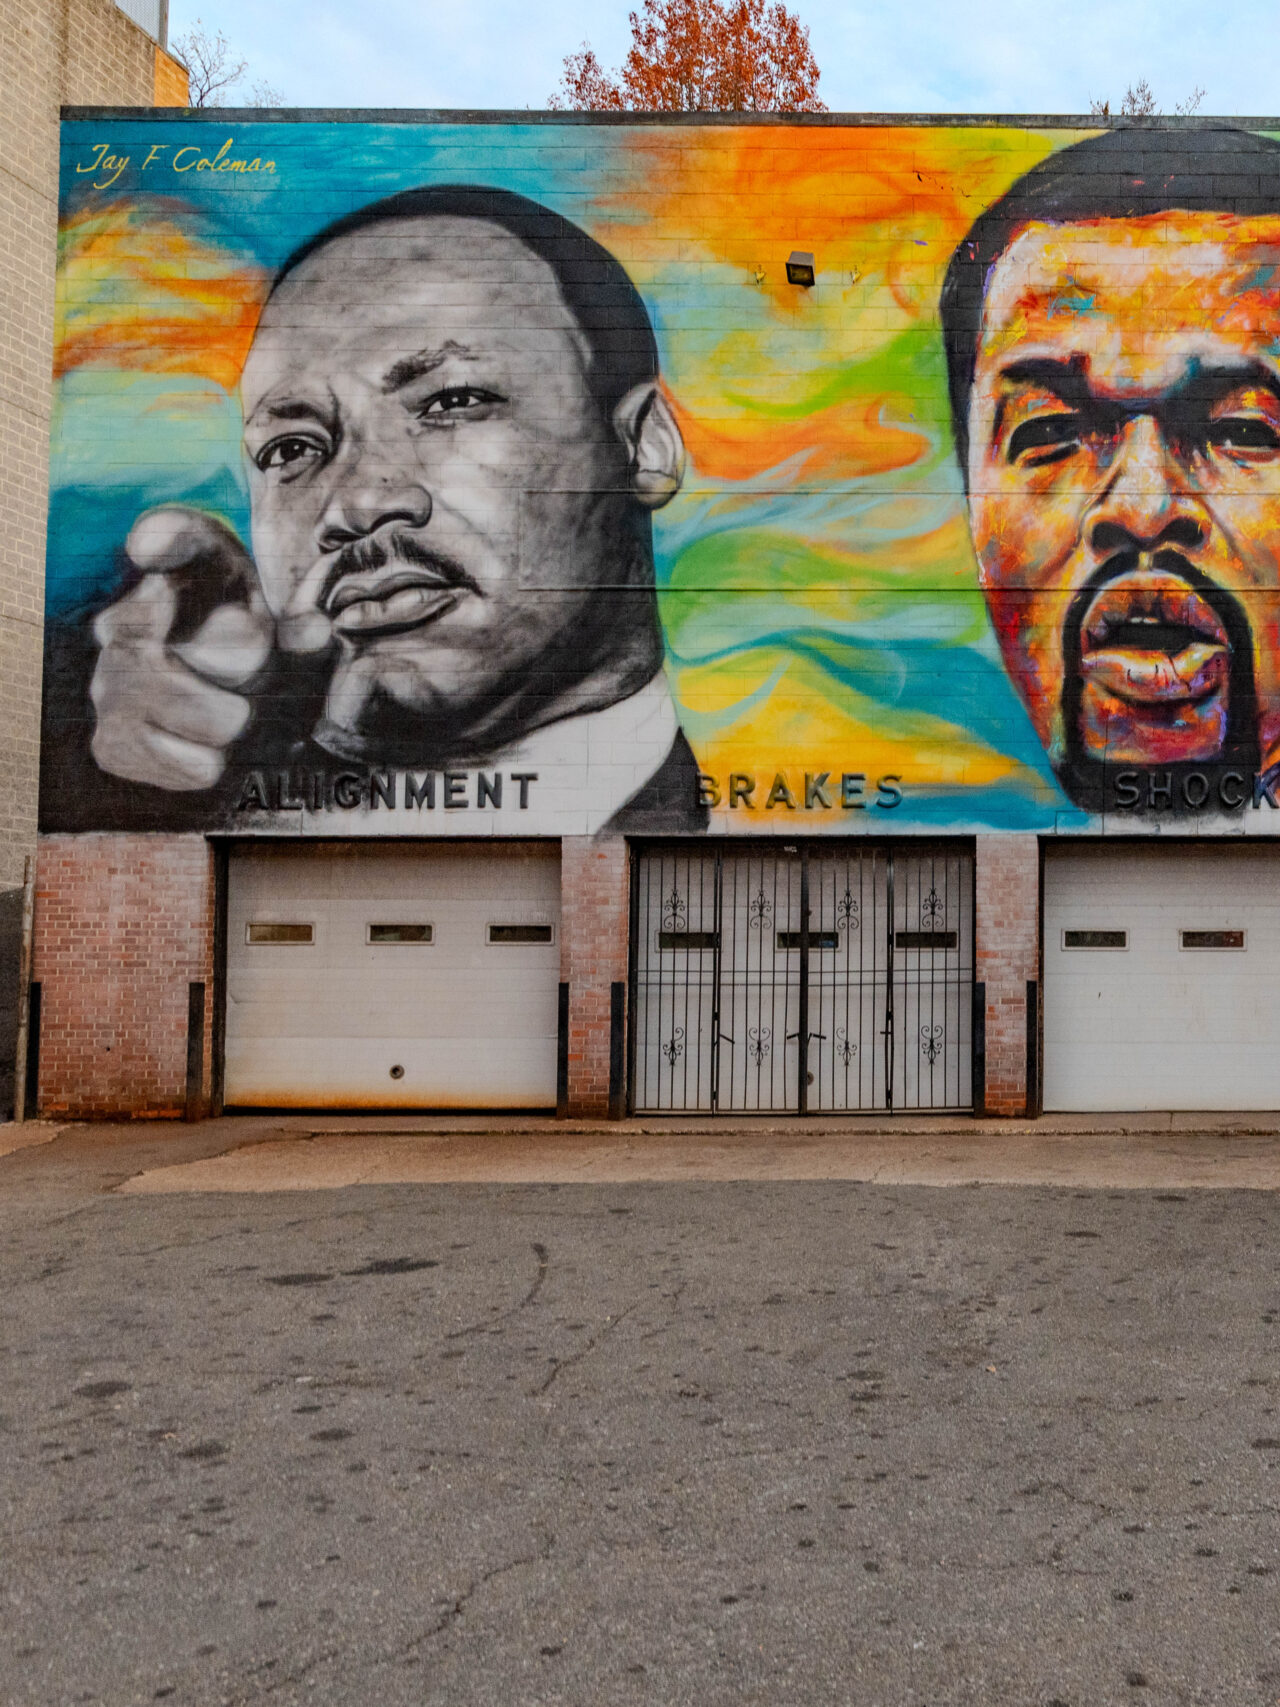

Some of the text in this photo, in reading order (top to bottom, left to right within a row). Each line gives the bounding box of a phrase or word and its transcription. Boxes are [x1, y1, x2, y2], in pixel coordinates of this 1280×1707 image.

[76, 144, 131, 189] Jay
[172, 138, 277, 174] Coleman
[238, 771, 539, 811] ALIGNMENT
[696, 772, 903, 809] BRAKES
